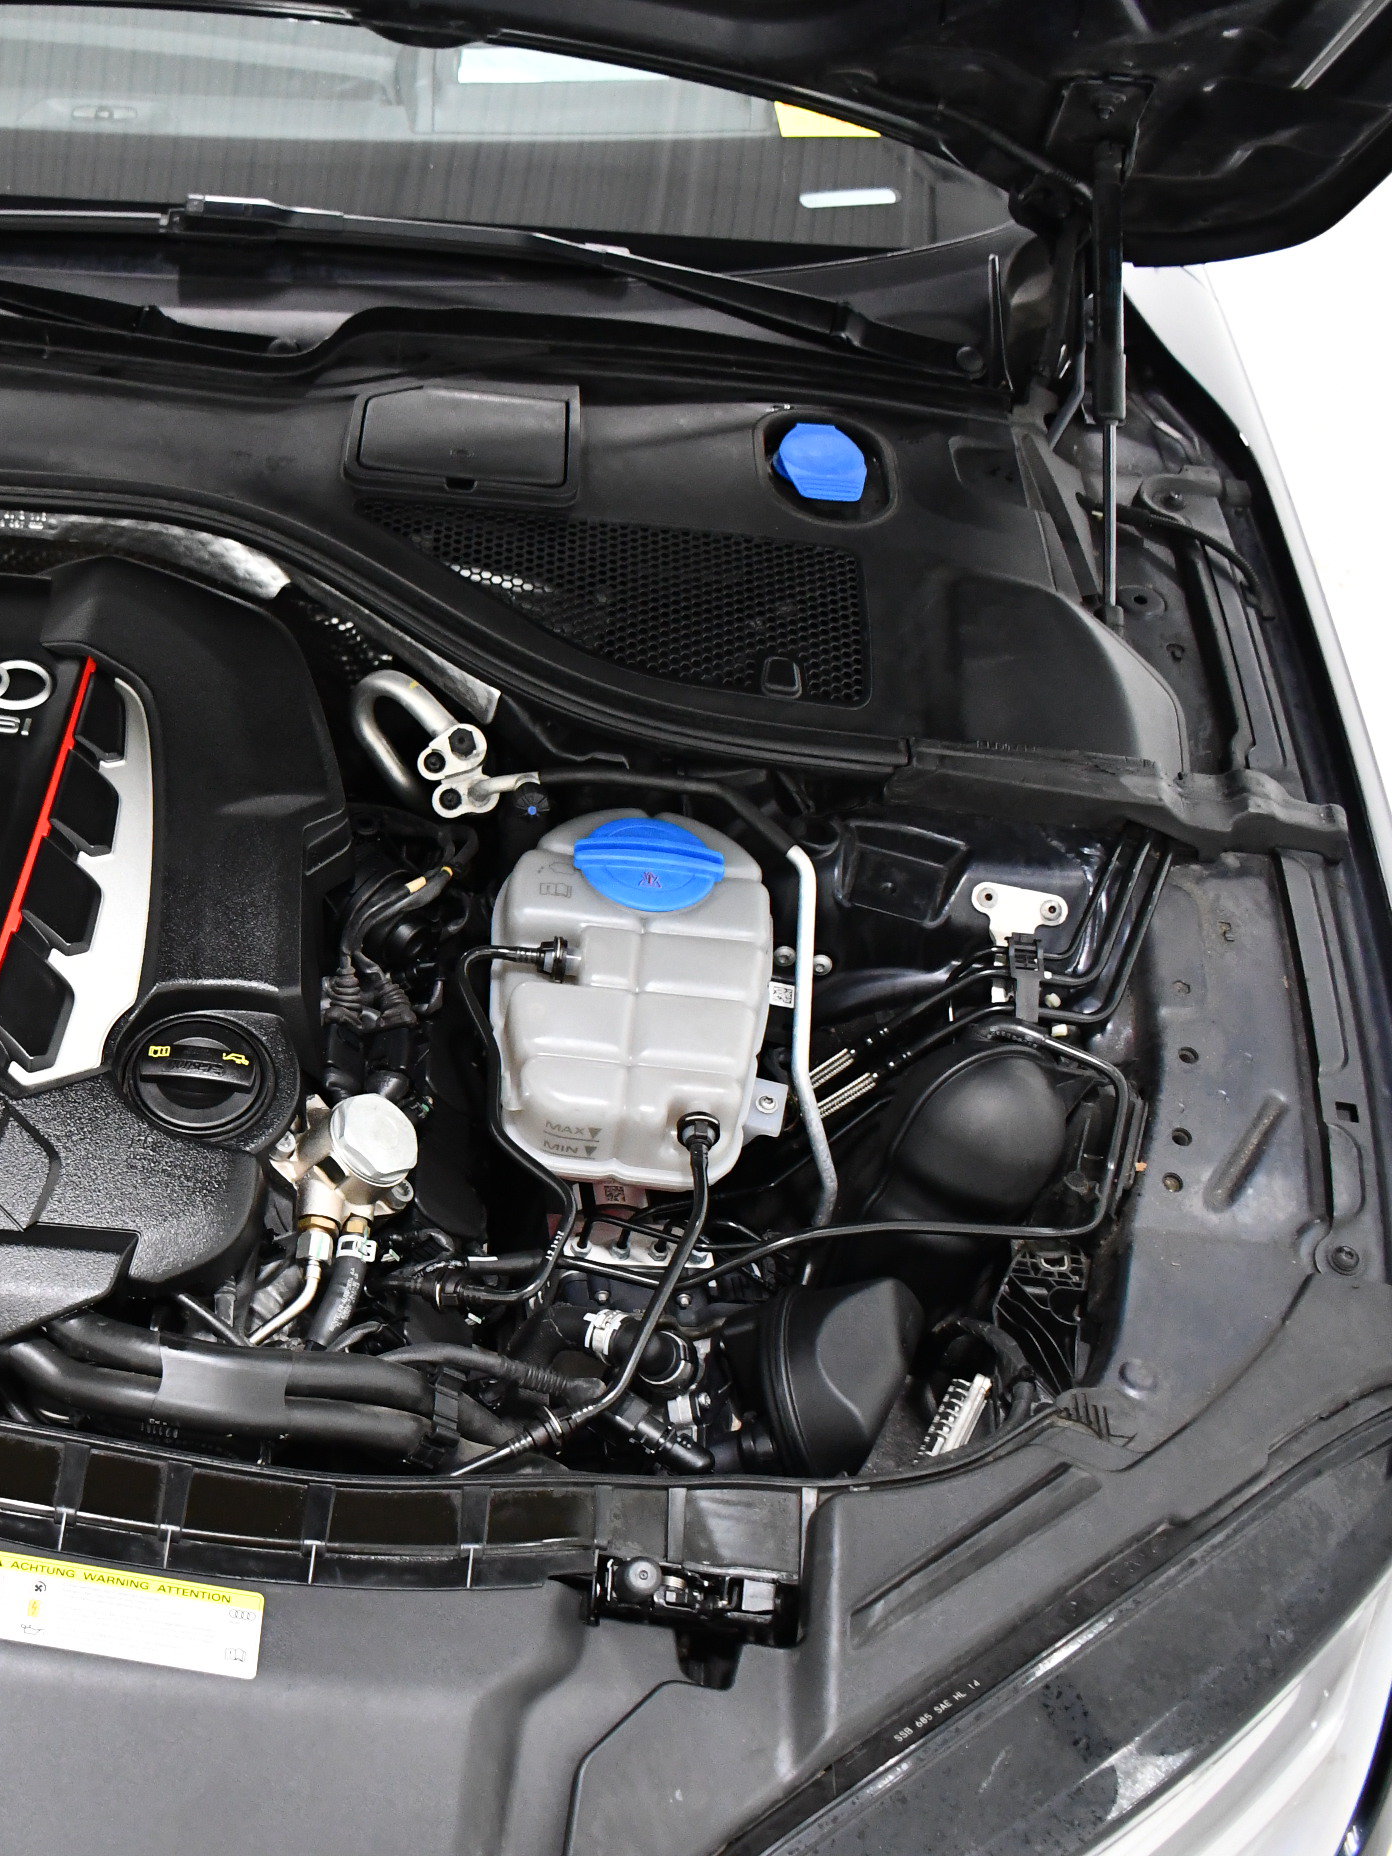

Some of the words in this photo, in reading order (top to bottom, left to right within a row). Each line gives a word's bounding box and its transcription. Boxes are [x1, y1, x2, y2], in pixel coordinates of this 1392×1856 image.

[545, 1121, 585, 1135] MAX
[543, 1141, 579, 1154] MIN
[10, 1560, 76, 1579] ACHTUNG
[83, 1572, 150, 1591] WARNING
[157, 1584, 232, 1604] ATTENTION
[933, 1699, 953, 1714] SAE
[952, 1690, 967, 1701] HL
